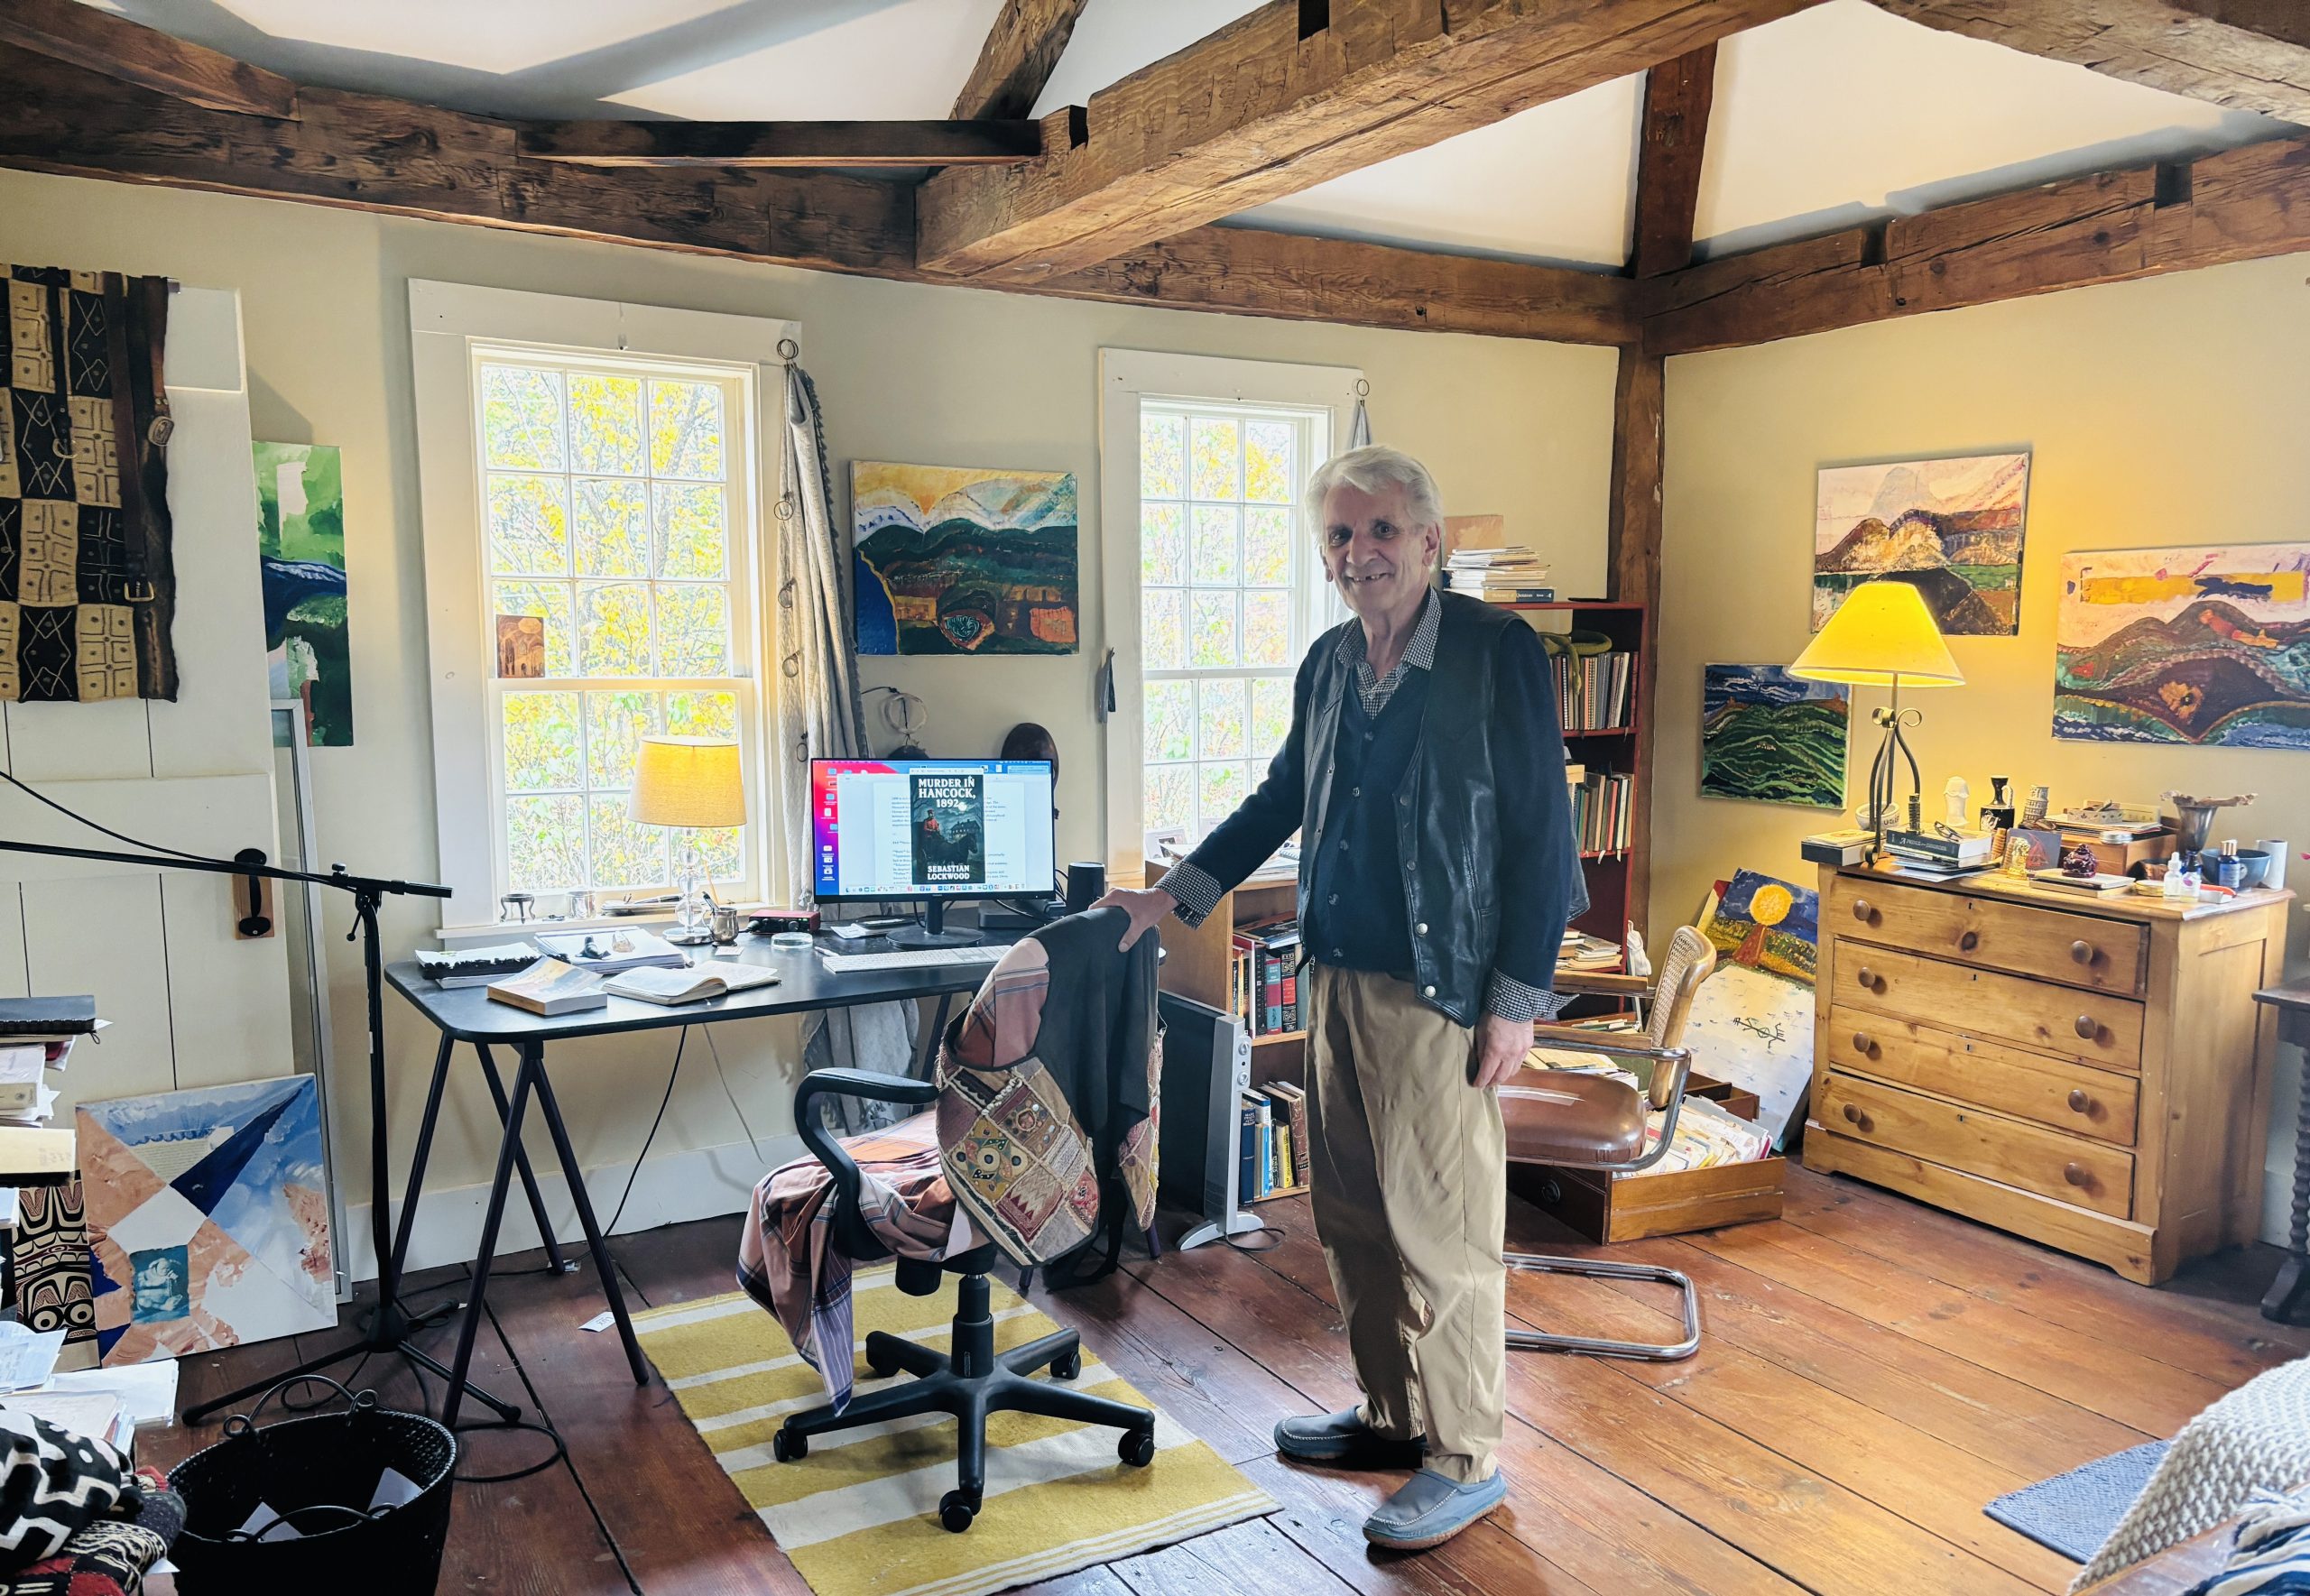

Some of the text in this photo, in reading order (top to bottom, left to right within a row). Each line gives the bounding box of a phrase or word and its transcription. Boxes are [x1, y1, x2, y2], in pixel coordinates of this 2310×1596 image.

[918, 779, 975, 788] MURDER IN
[919, 788, 976, 799] HANCOCK,
[936, 798, 959, 808] 1892
[927, 865, 970, 873] SEBASTIAN
[927, 872, 970, 881] LOCKWOOD
